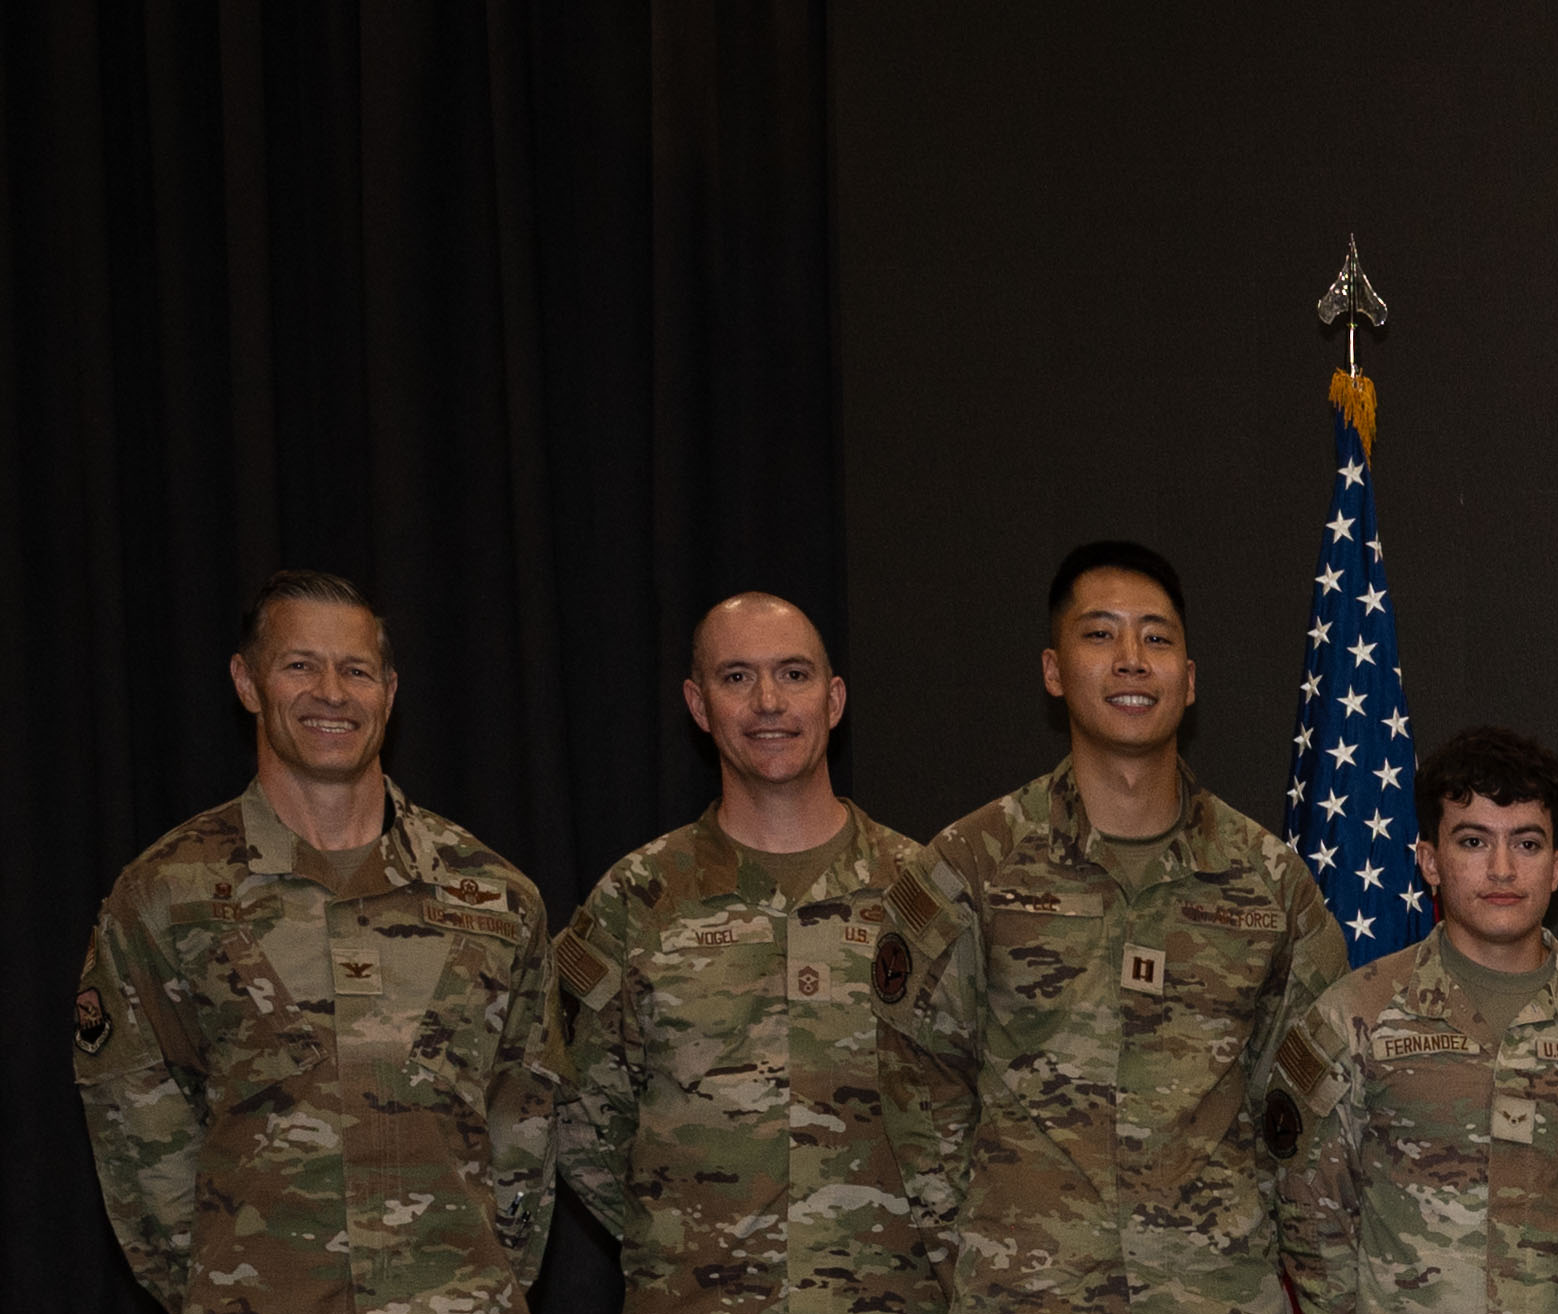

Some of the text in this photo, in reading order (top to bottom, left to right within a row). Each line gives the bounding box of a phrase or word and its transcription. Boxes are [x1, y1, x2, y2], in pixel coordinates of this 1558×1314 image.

[1238, 911, 1278, 929] FORCE
[695, 929, 739, 945] VOGEL
[846, 927, 870, 944] U.S.
[1385, 1034, 1470, 1057] FERNANDEZ
